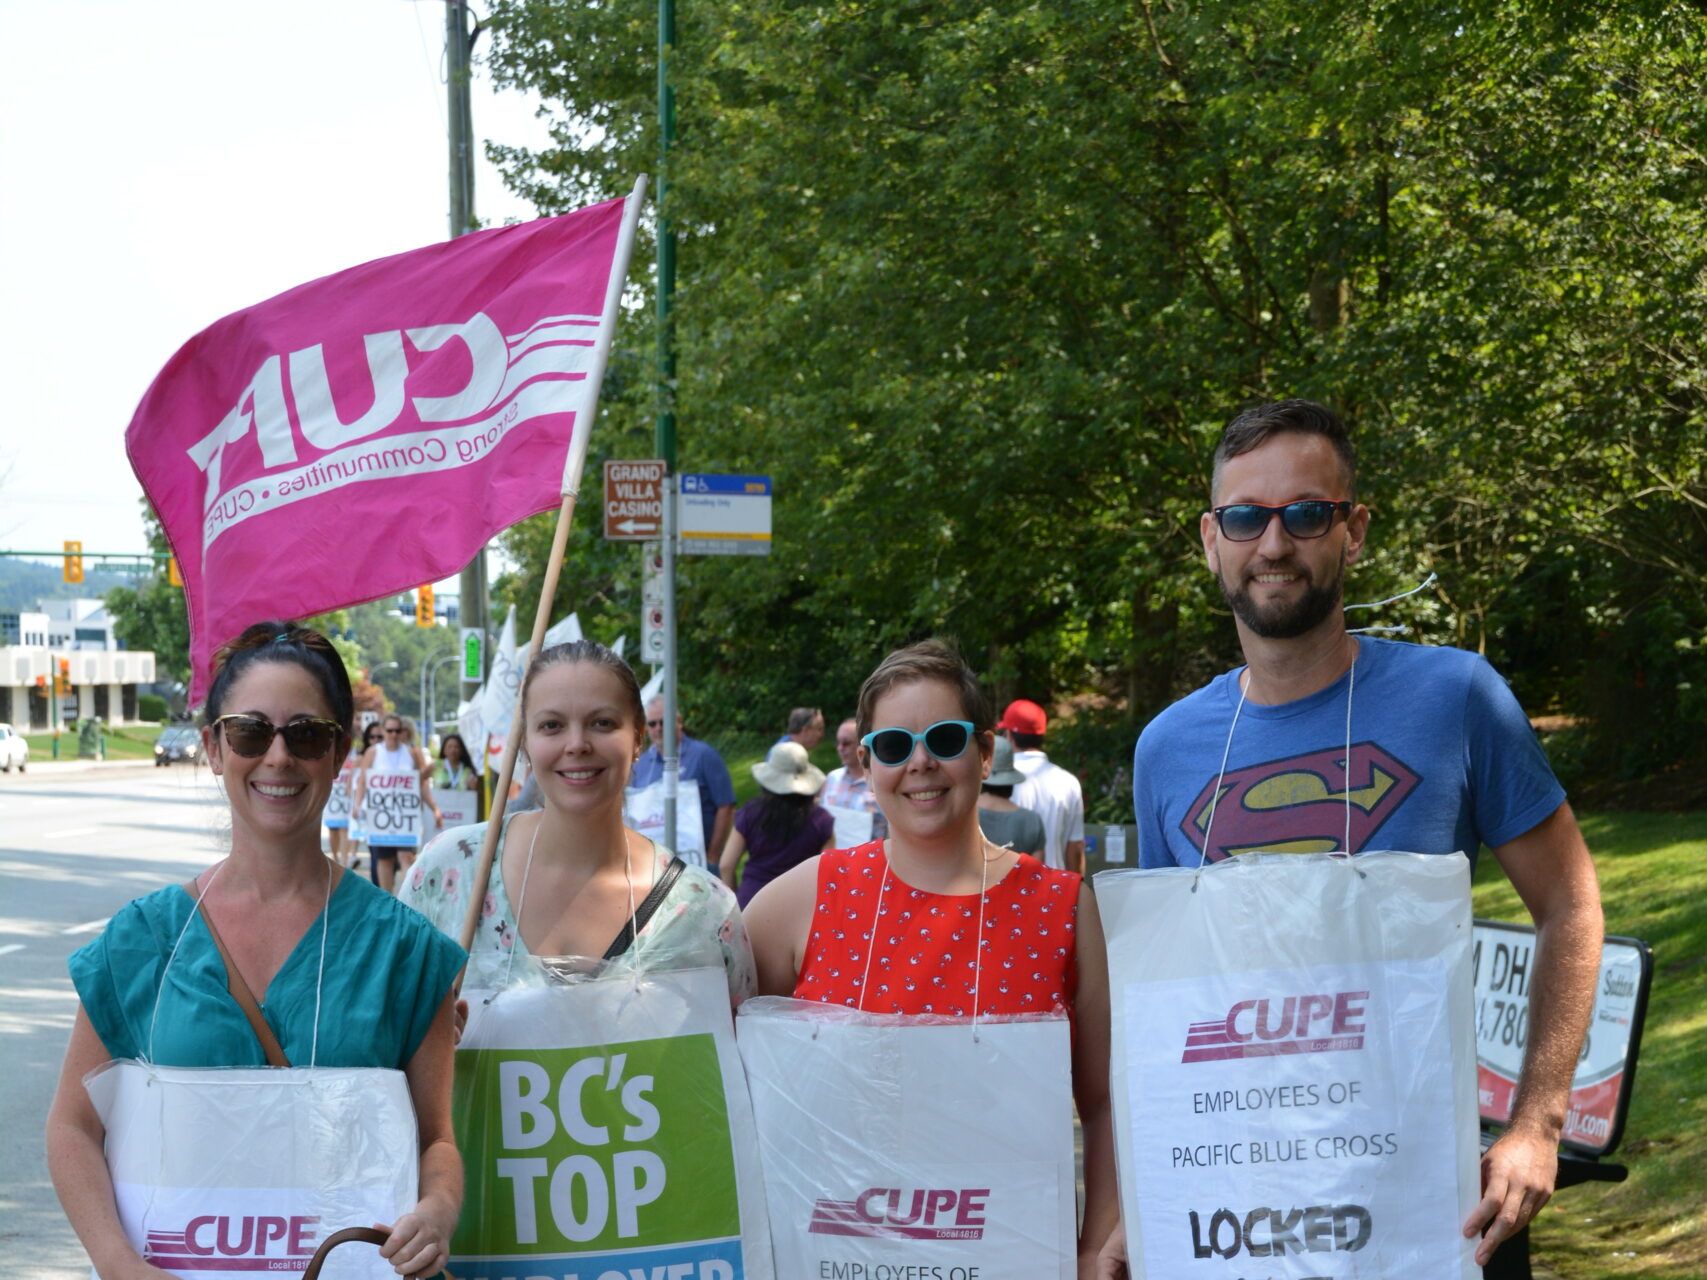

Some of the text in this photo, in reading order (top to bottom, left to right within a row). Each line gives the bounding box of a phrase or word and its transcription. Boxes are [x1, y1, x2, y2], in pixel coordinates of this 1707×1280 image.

[610, 465, 660, 482] GRAND
[614, 483, 655, 498] VILLA
[608, 501, 662, 517] CASINO
[370, 774, 415, 789] CUPE
[327, 797, 350, 814] OU
[367, 789, 421, 810] LOCKED
[374, 811, 418, 832] OUT
[1490, 942, 1530, 998] DH
[1225, 991, 1370, 1043] CUPE
[1311, 1039, 1335, 1050] Local
[499, 1053, 661, 1149] BC's
[1193, 1081, 1361, 1114] EMPLOYEES OF
[1172, 1133, 1398, 1168] PACIFIC BLUE CROSS
[497, 1150, 667, 1244] TOP
[856, 1187, 990, 1225] CUPE
[184, 1215, 321, 1257] CUPE
[936, 1230, 979, 1239] Local 1816
[1189, 1204, 1372, 1260] LOCKED
[268, 1260, 290, 1270] Local
